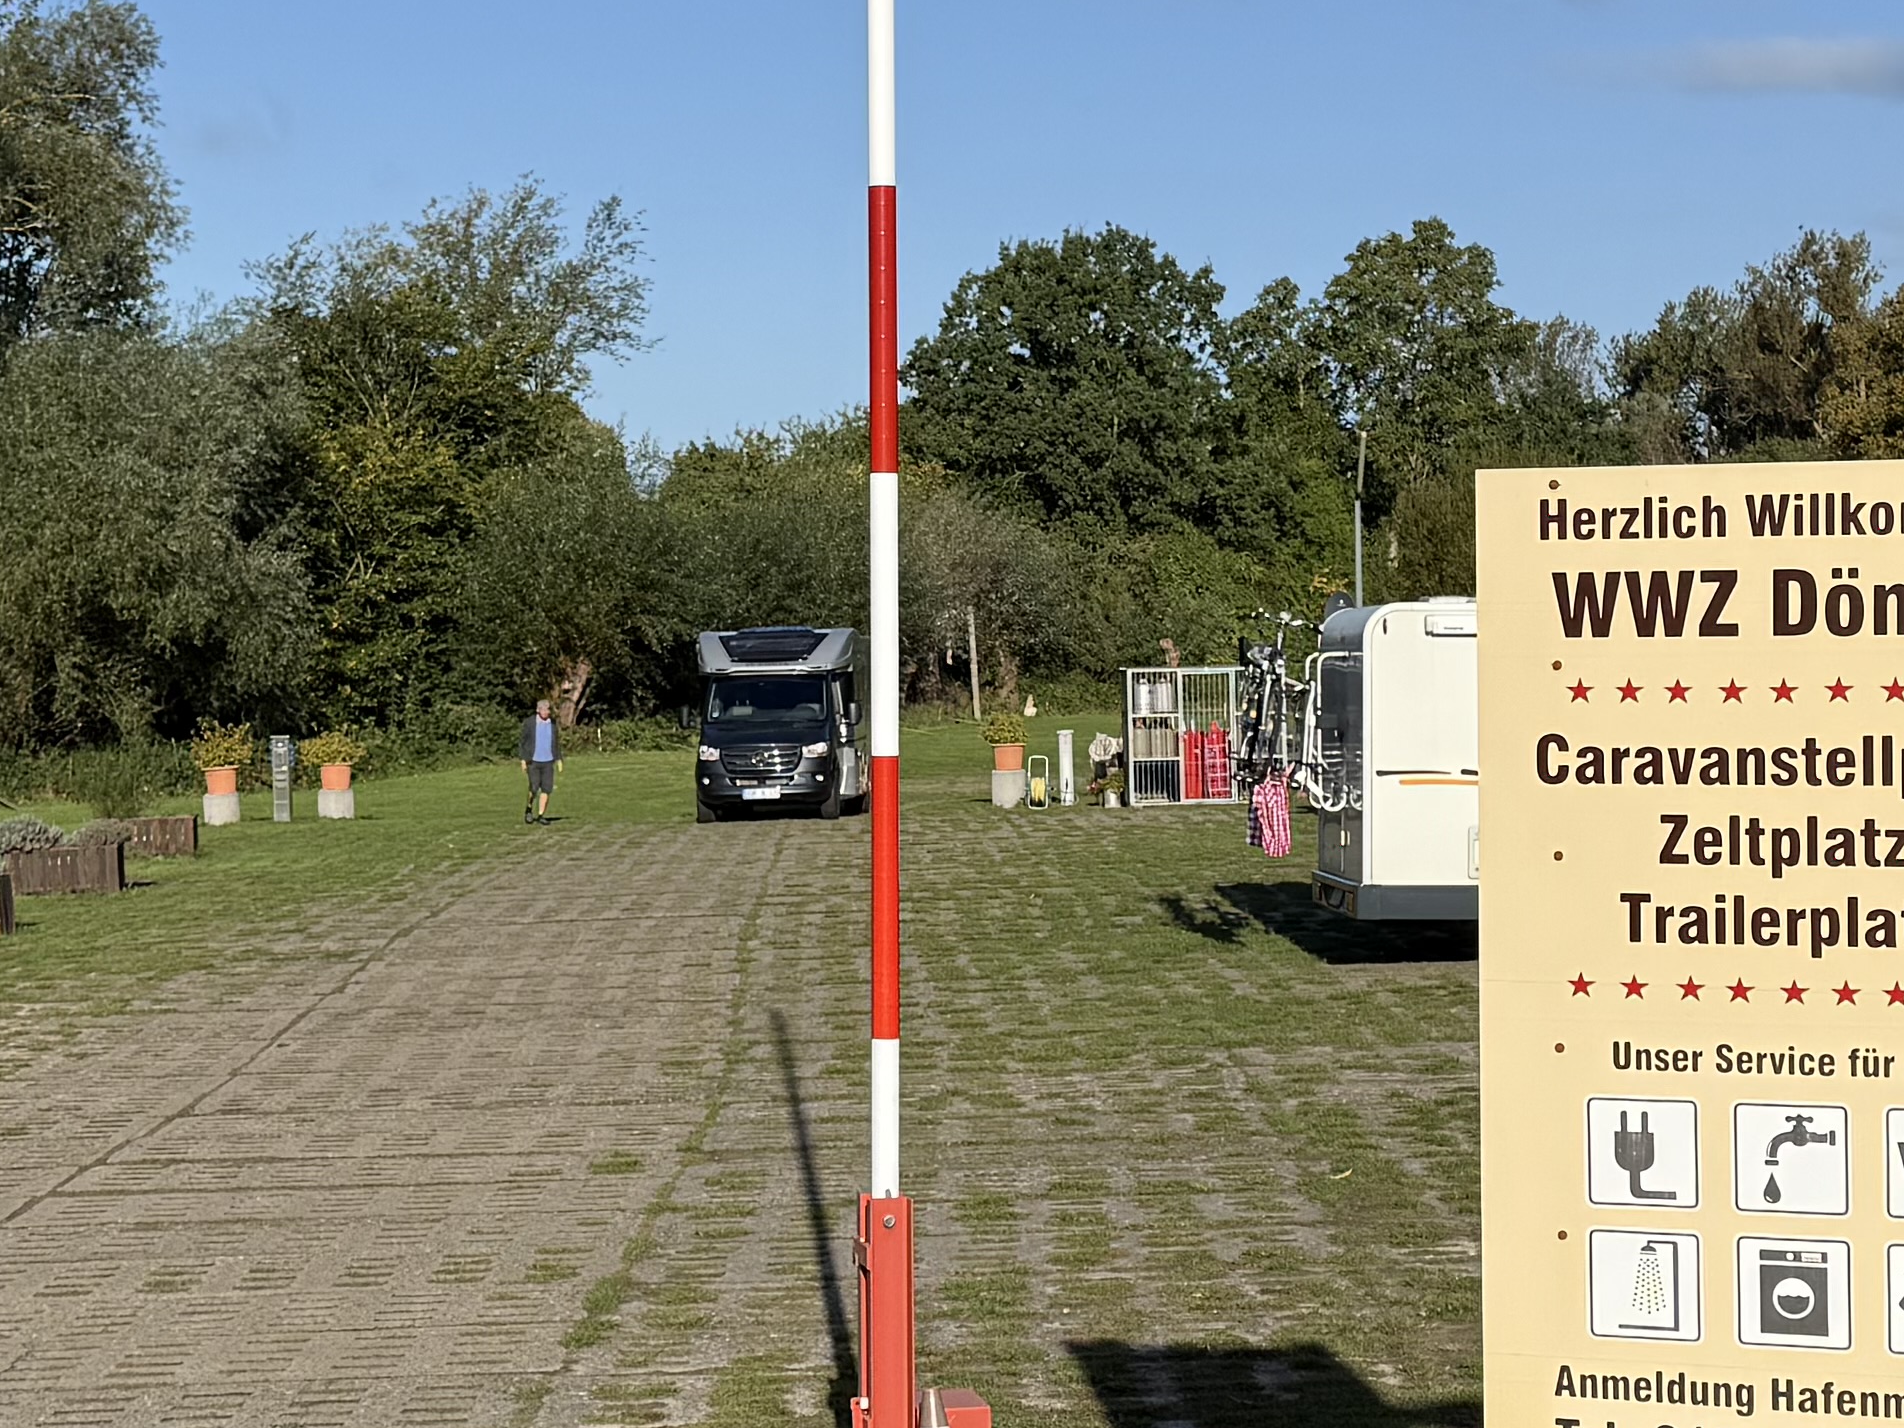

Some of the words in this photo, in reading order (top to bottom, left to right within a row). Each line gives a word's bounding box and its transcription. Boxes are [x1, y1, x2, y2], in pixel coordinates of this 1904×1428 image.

[1539, 495, 1727, 541] Herzlich
[1551, 569, 1739, 638] WWZ
[1612, 1041, 1703, 1073] Unser
[1715, 1043, 1835, 1077] Service
[1848, 1048, 1895, 1078] für
[1554, 1364, 1755, 1416] Anmeldung
